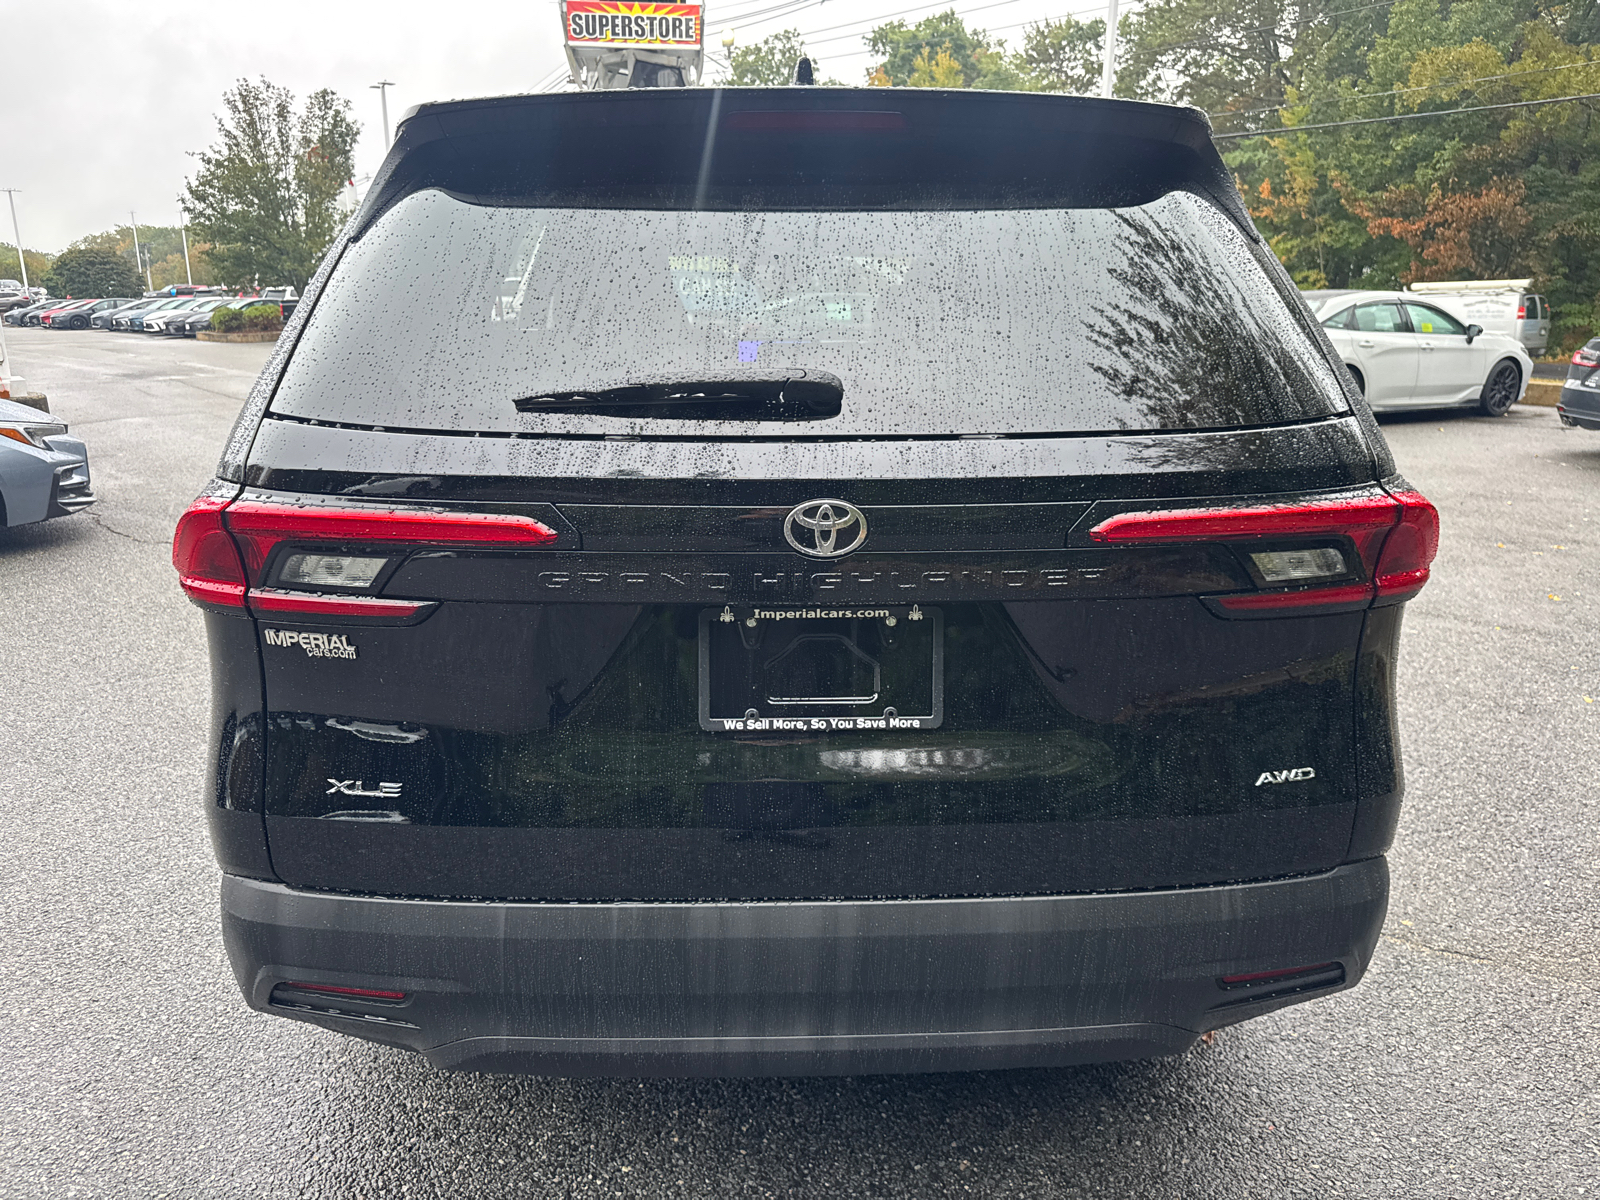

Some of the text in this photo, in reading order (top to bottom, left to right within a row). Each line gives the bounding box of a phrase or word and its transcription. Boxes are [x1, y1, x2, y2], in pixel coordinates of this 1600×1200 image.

[570, 13, 695, 40] SUPERSTORE
[538, 568, 1107, 591] GRAND HIGHLANDER
[753, 608, 889, 621] Imperialcars.com
[264, 628, 356, 651] IMPERIAL
[306, 646, 357, 660] cars.com
[723, 717, 921, 731] We Sell More, So You Save More
[1254, 766, 1316, 787] AWD
[325, 778, 403, 798] XLE
